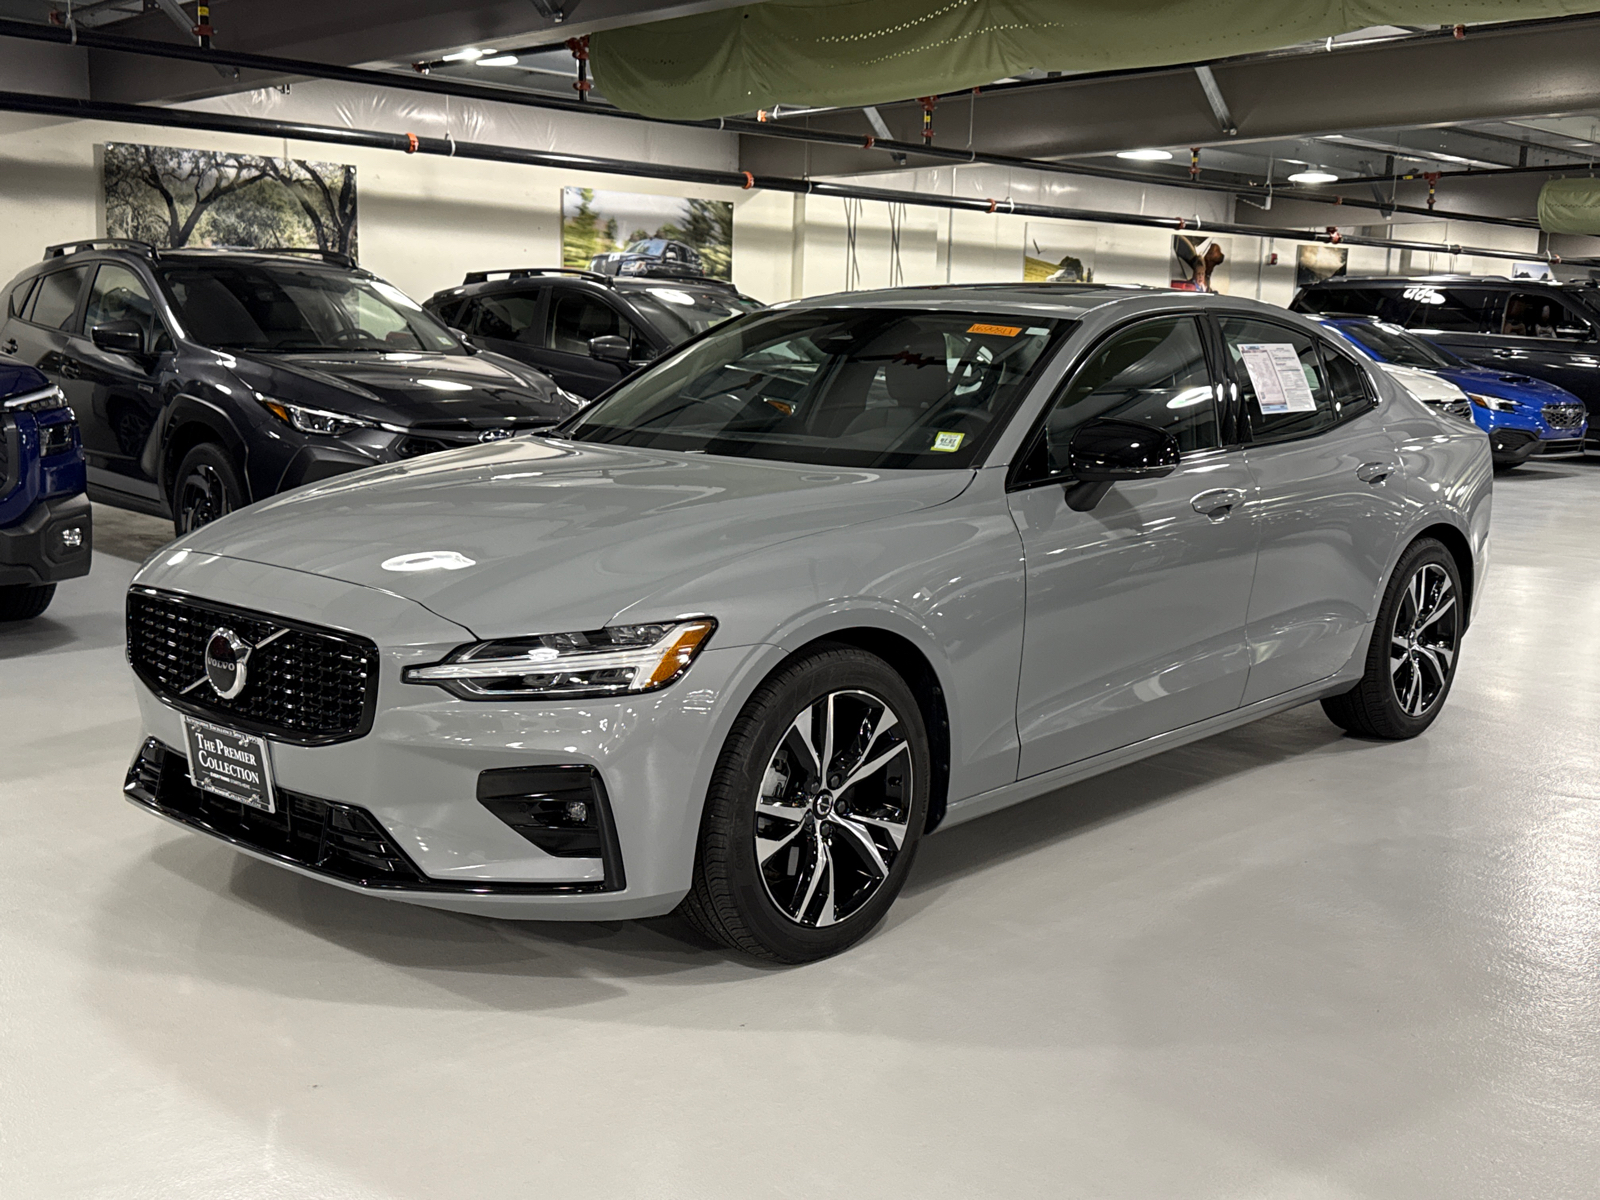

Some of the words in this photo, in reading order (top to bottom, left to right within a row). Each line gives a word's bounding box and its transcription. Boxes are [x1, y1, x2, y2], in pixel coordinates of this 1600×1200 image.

[207, 657, 235, 671] VOLVO
[195, 732, 216, 753] THE
[215, 738, 257, 766] PREMIER
[198, 750, 260, 784] COLLECTION
